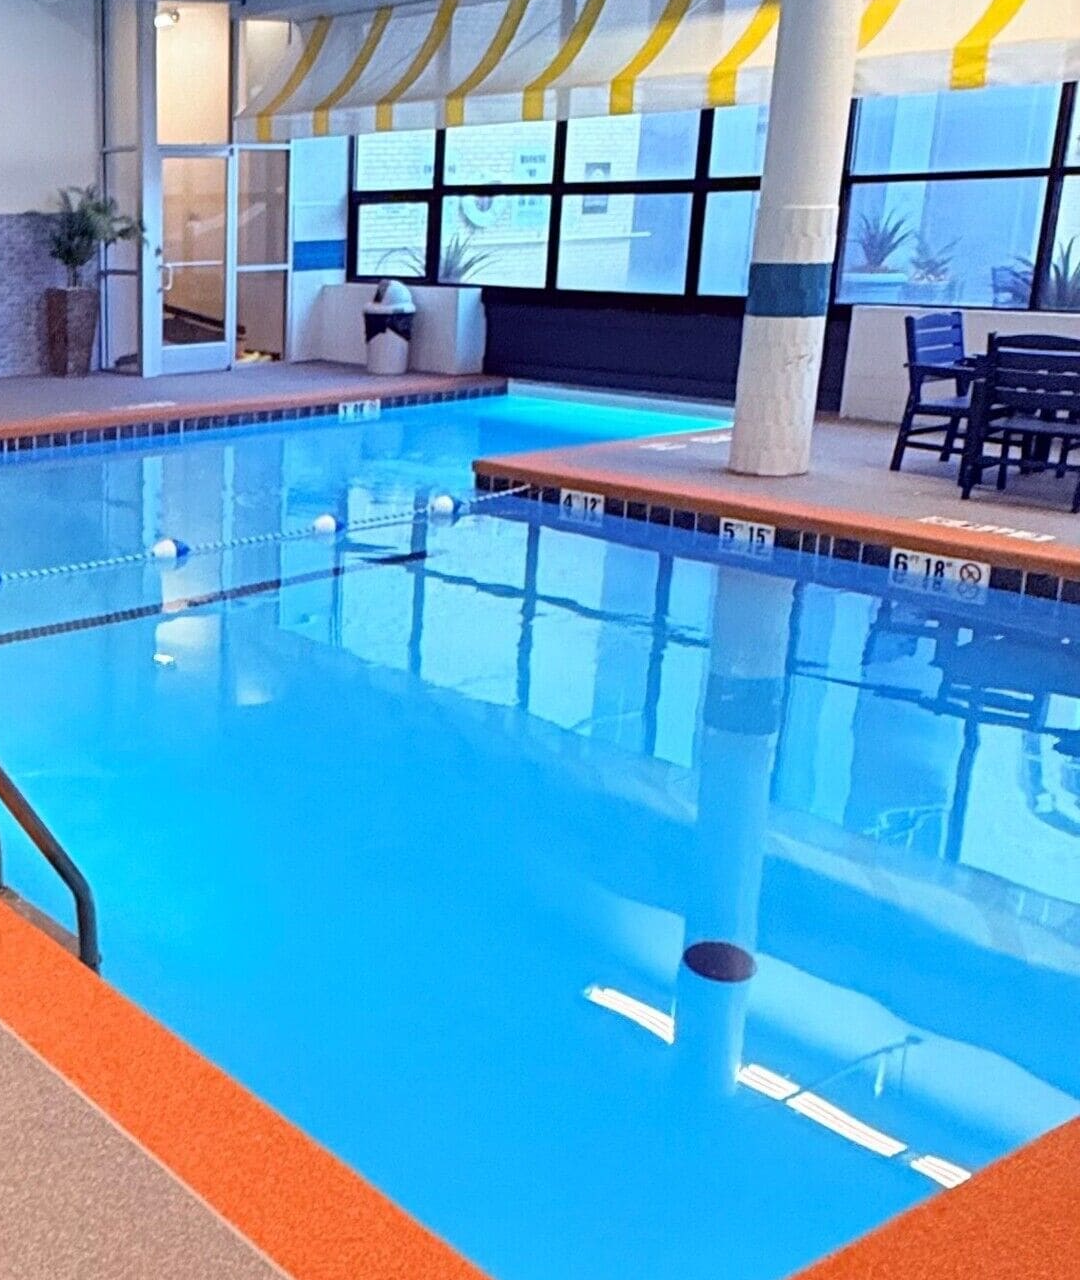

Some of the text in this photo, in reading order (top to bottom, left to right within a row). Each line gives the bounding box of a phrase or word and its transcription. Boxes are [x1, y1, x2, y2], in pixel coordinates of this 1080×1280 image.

[563, 493, 597, 512] 4 12
[724, 522, 735, 539] 5
[749, 526, 765, 543] 15
